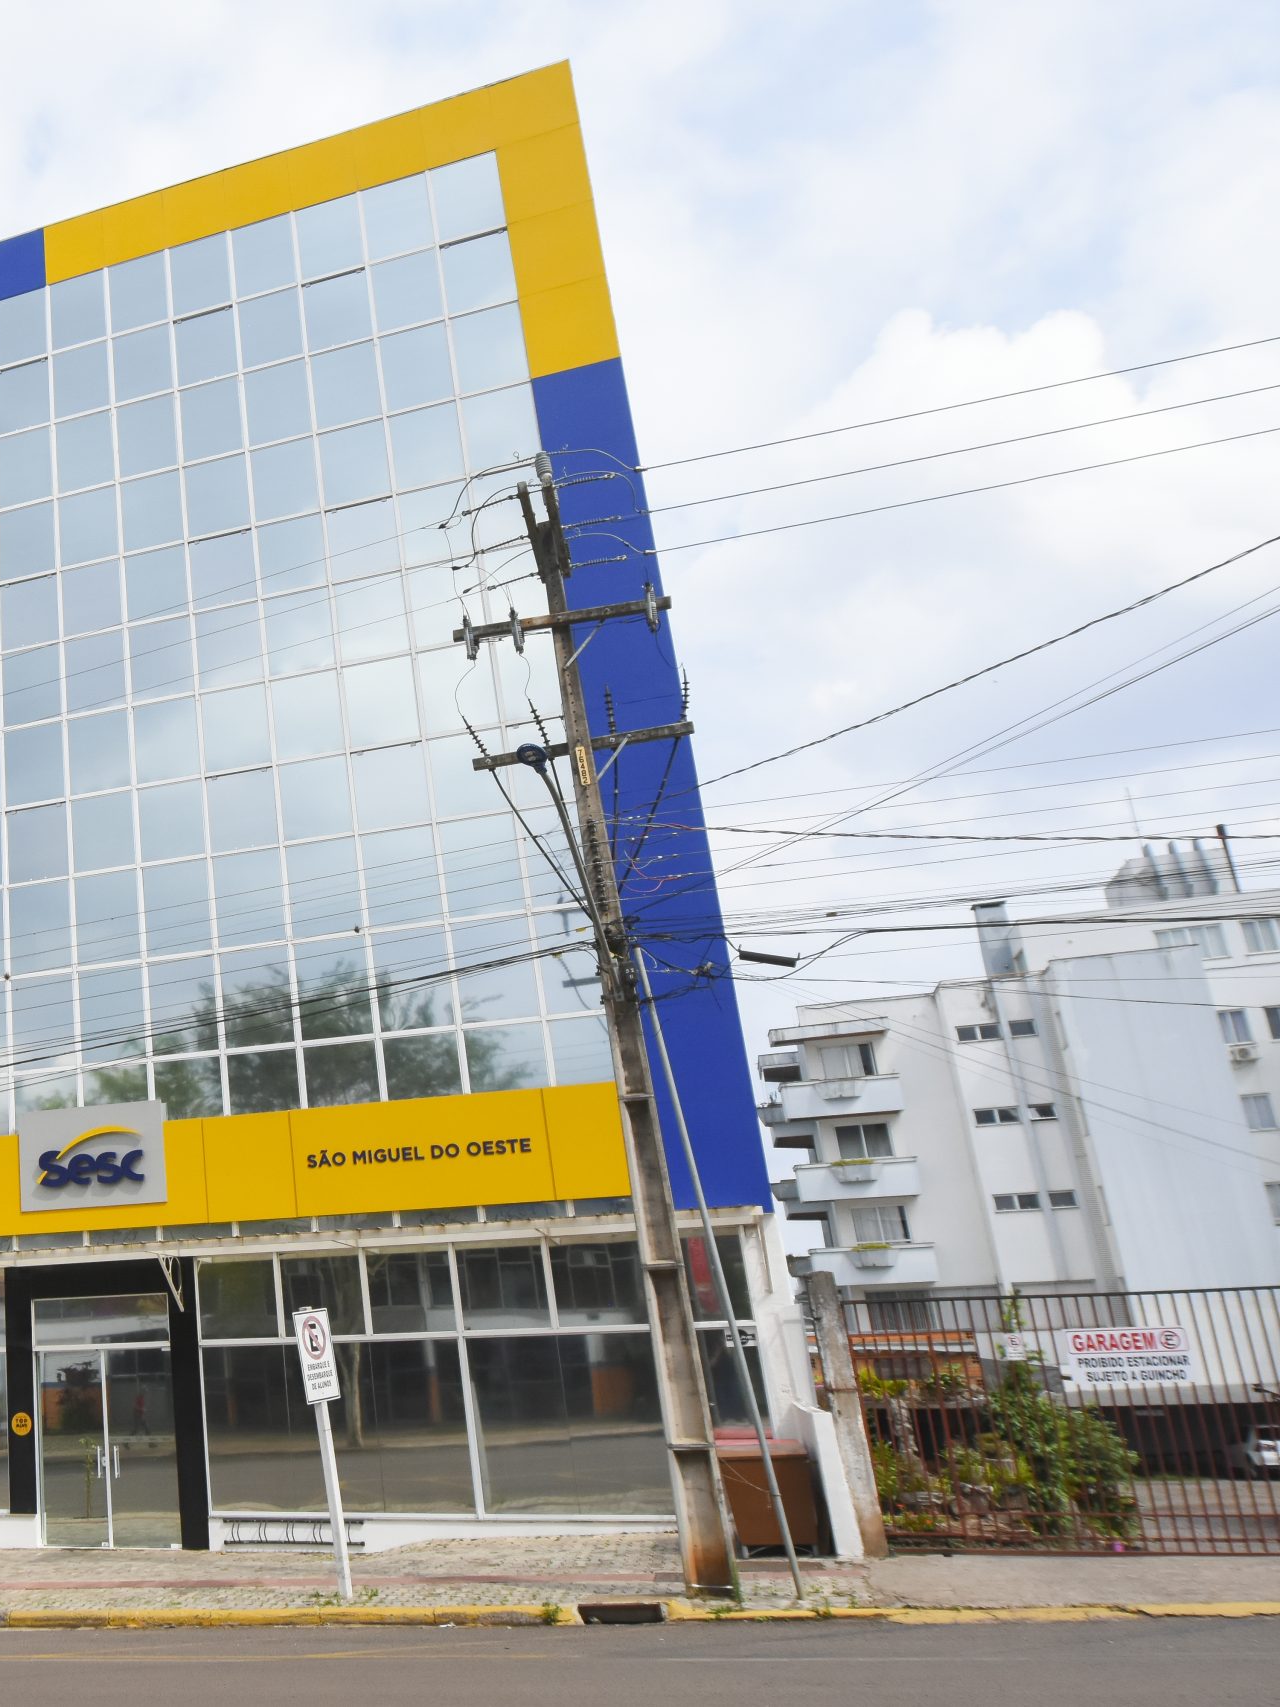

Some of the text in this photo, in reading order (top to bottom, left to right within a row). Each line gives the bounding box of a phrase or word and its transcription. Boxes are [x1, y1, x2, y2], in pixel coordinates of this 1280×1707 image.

[576, 749, 588, 784] 76482
[307, 1138, 532, 1168] SÃO MIGUEL DO OESTE
[308, 1323, 320, 1352] E
[1072, 1333, 1157, 1351] GARAGEM
[1078, 1355, 1190, 1368] PROIBIDO ESTACIONAR
[307, 1370, 333, 1381] DESEMBARQUE
[1086, 1369, 1187, 1382] SUJEITO A GUINCHO
